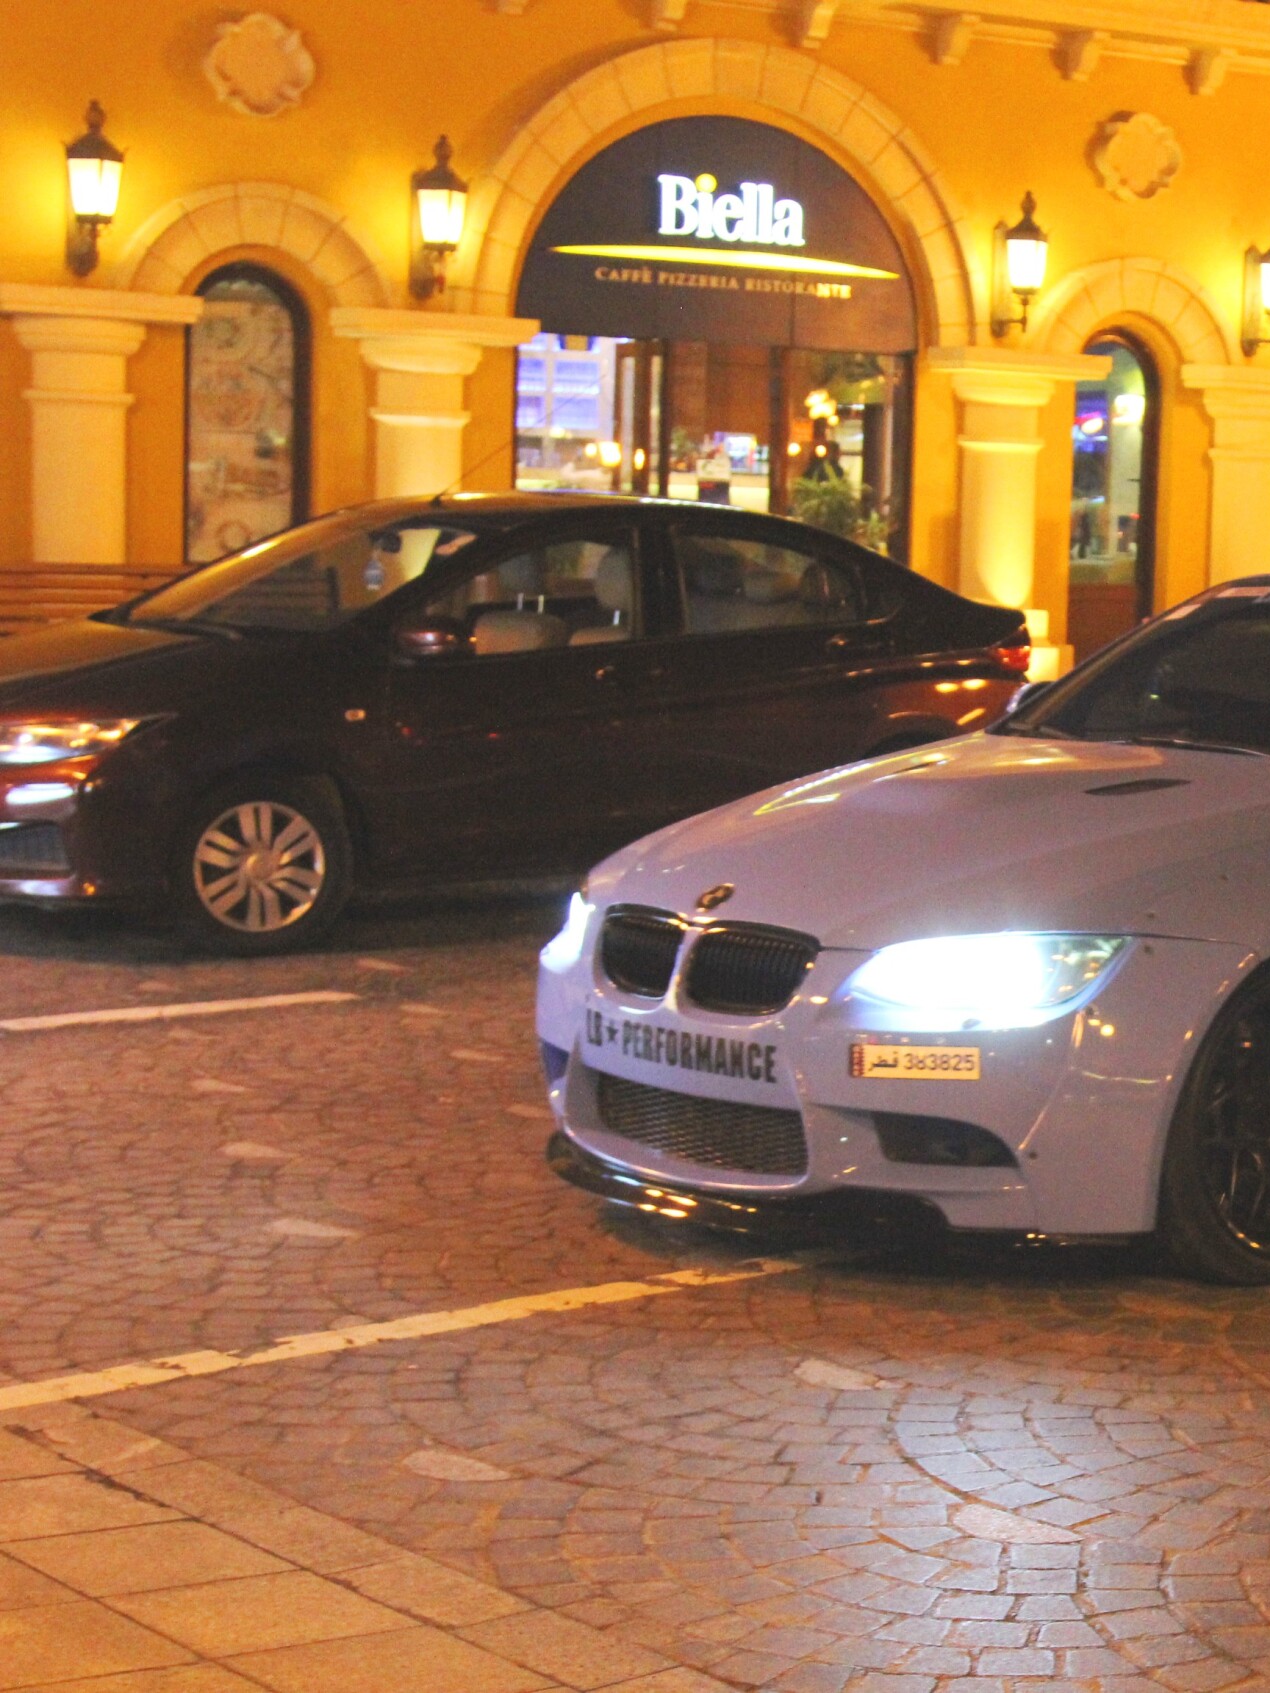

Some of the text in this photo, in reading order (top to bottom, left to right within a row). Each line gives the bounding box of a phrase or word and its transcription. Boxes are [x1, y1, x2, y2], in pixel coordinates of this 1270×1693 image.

[657, 173, 805, 246] Biella
[658, 271, 739, 290] PIZZERIA
[745, 278, 852, 299] RISTORANTE
[622, 1019, 777, 1083] PERFORMANCE
